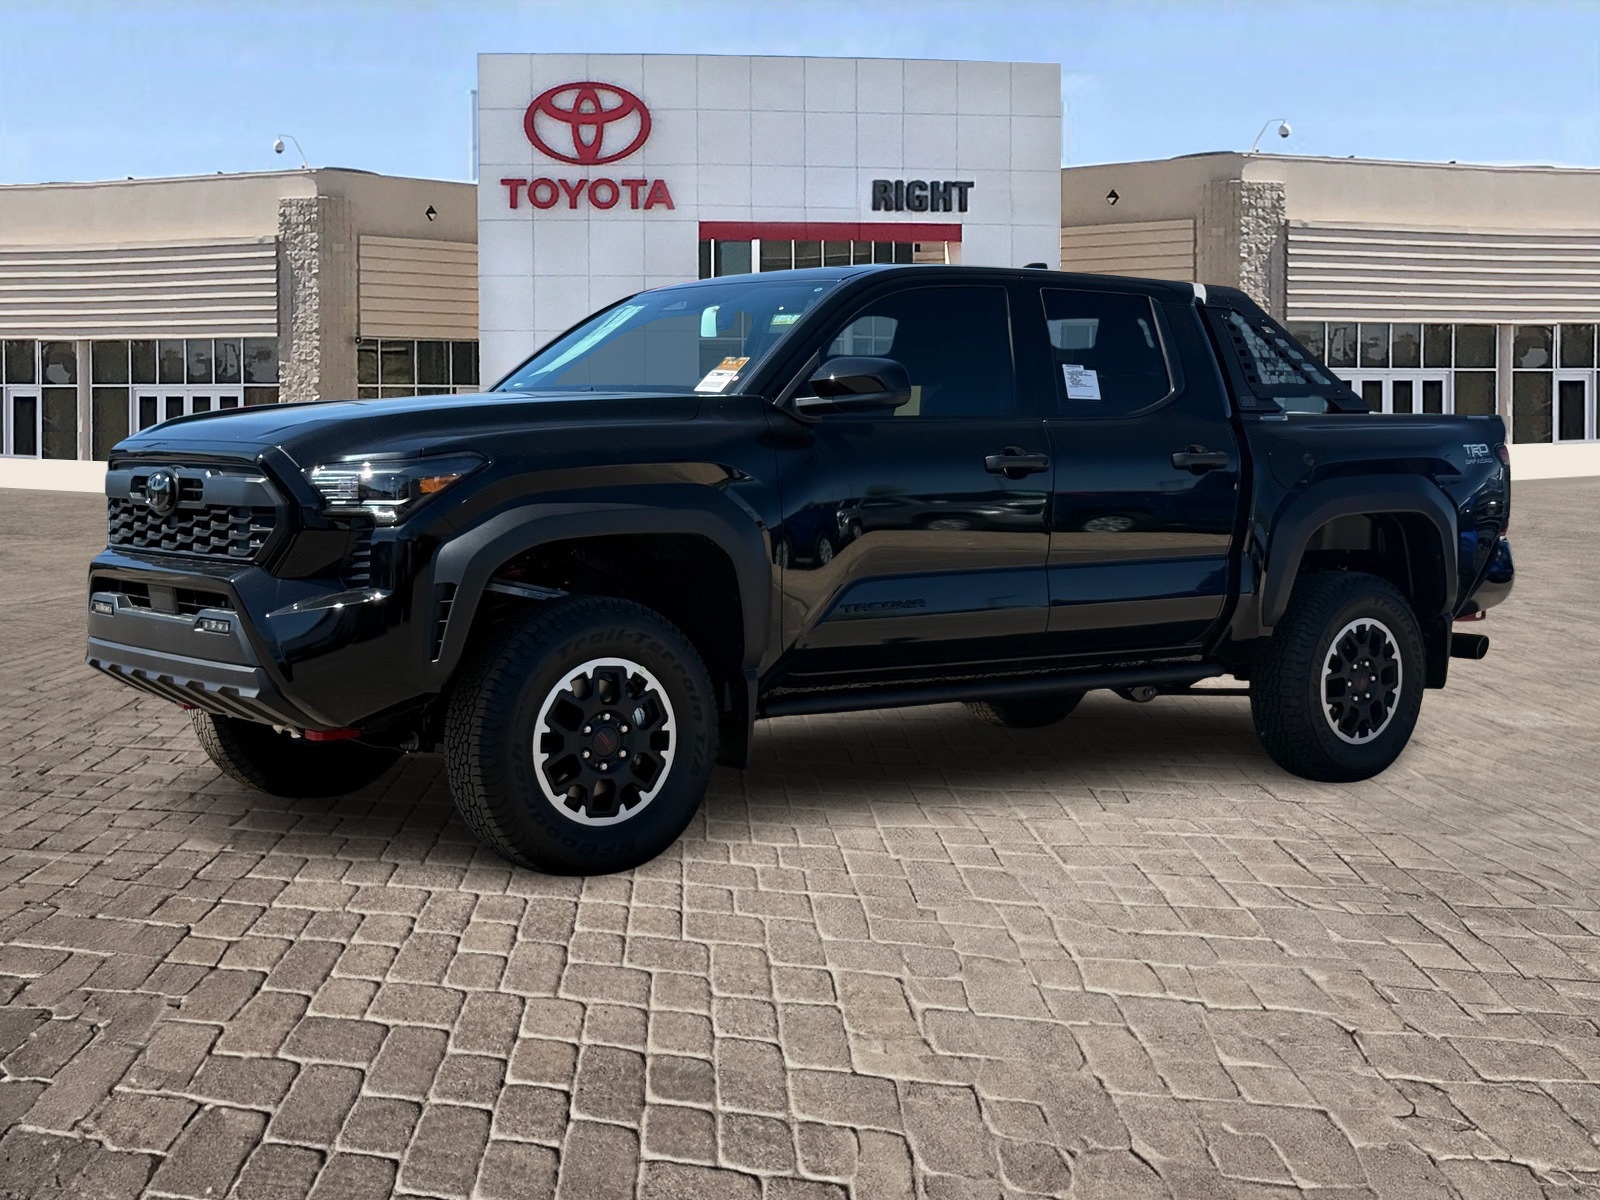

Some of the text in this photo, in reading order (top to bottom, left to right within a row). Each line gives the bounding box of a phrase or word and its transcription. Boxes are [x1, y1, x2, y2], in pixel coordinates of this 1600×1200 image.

[500, 178, 675, 210] TOYOTA
[871, 179, 975, 213] RIGHT
[1462, 443, 1489, 457] TRD
[839, 599, 926, 612] TACOMA
